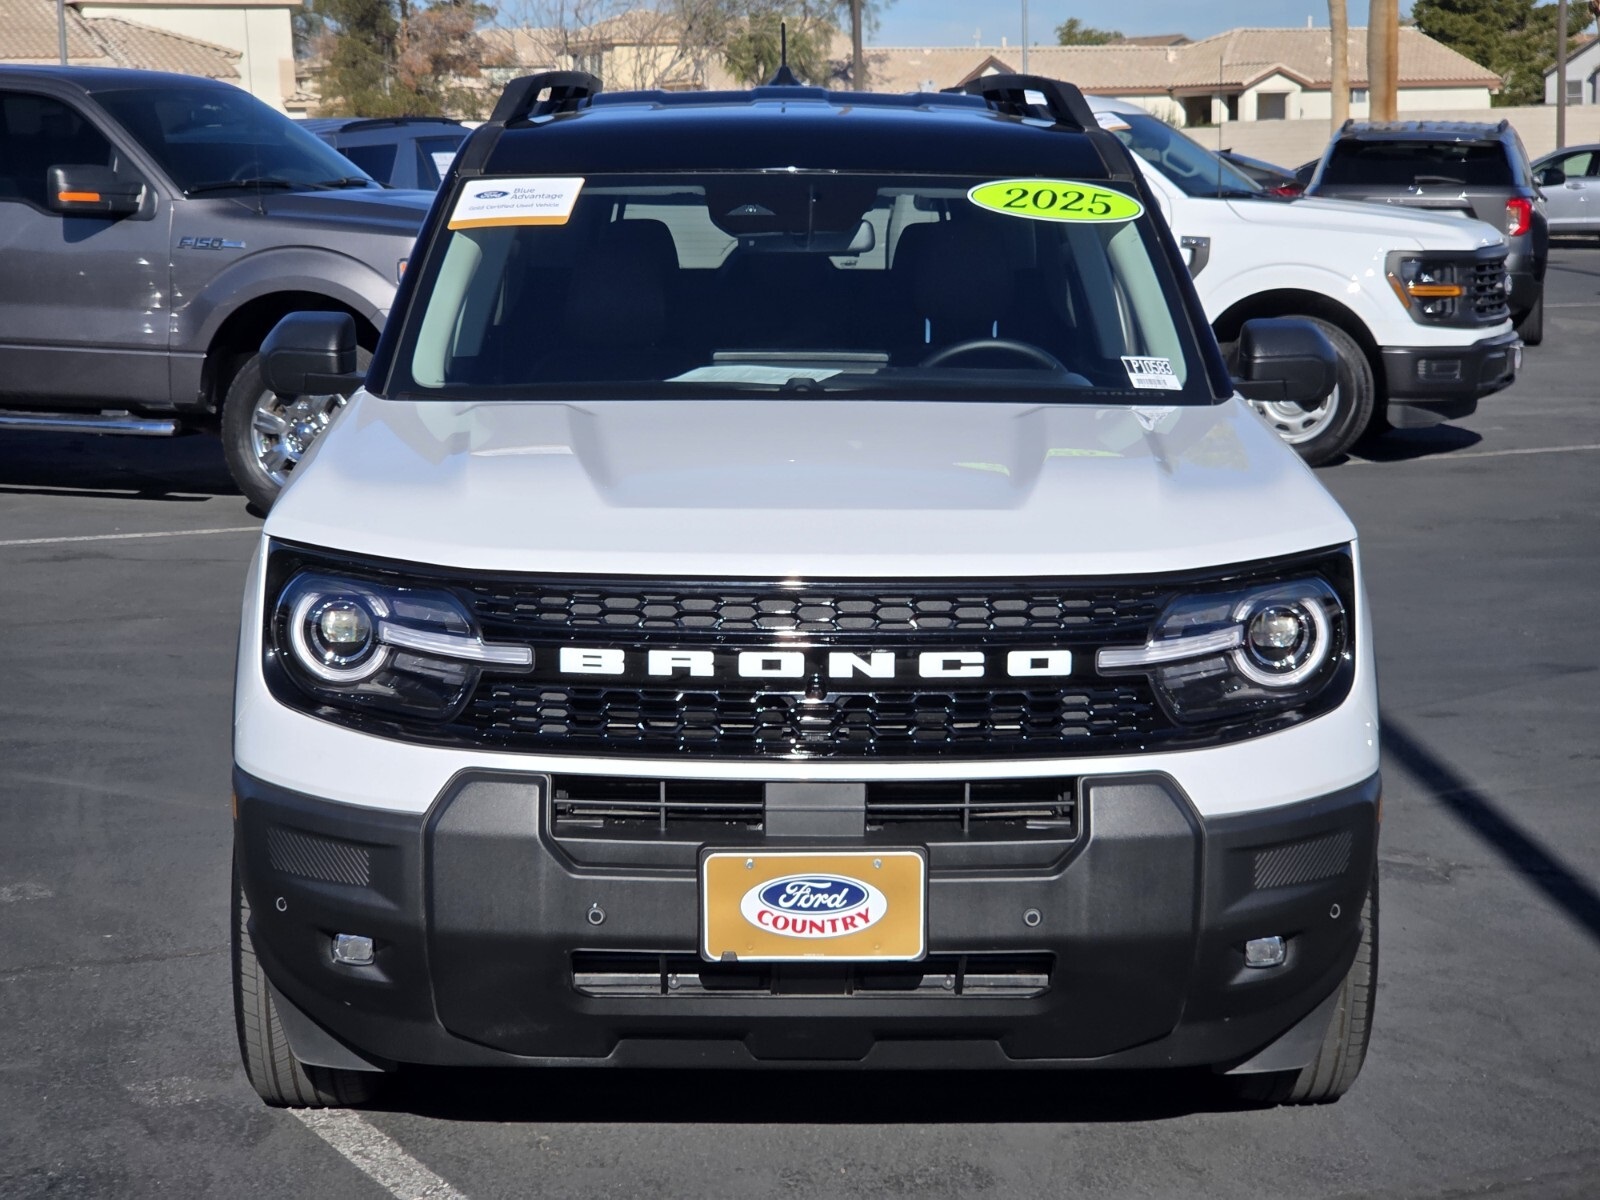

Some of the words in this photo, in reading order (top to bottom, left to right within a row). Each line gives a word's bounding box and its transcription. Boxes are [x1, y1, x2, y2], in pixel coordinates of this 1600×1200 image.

[1003, 188, 1113, 216] 2025
[560, 647, 1073, 679] BRONCO
[778, 881, 850, 909] Ford
[757, 907, 871, 934] COUNTRY
